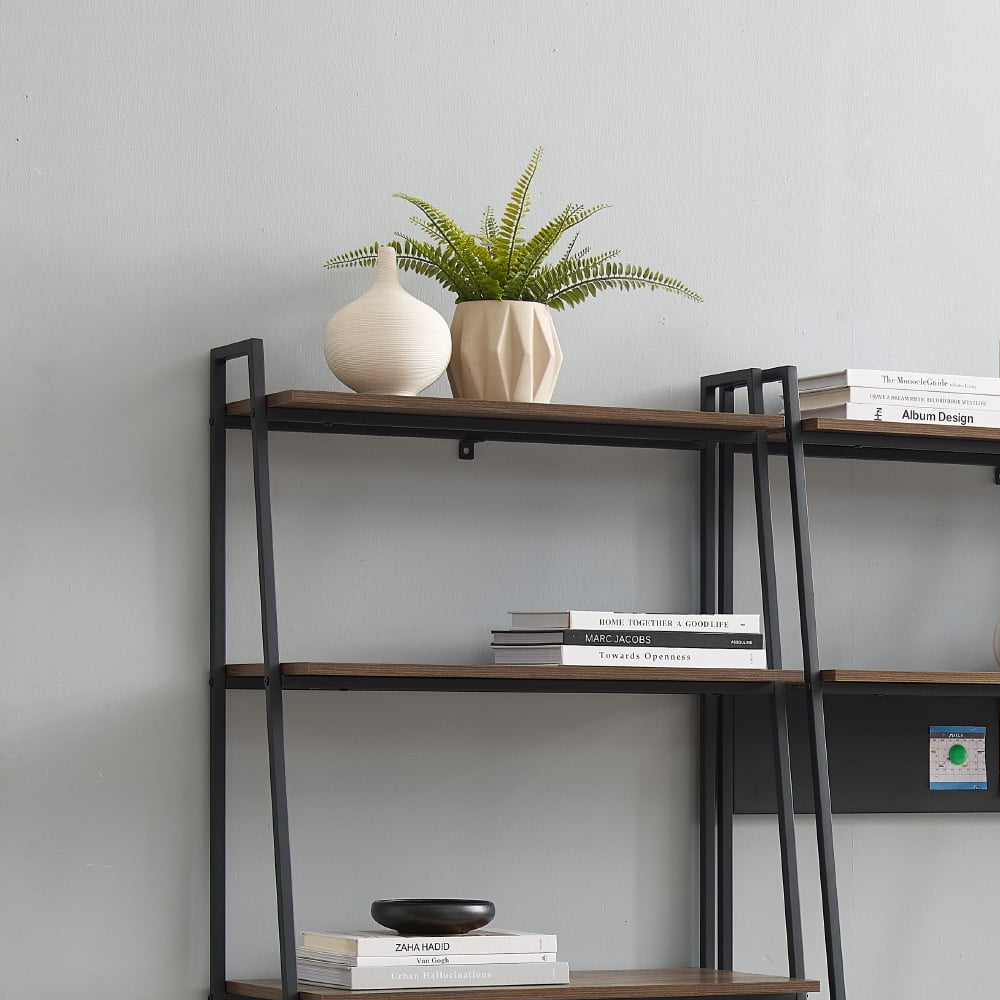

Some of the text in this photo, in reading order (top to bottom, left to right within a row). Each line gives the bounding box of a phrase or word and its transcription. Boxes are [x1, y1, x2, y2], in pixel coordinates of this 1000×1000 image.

[882, 375, 896, 384] The
[902, 410, 974, 425] Album Design
[599, 619, 625, 627] HOME
[628, 619, 673, 627] TOGETHER
[585, 634, 651, 644] MARC JACOBS
[598, 651, 691, 662] Towards Openness
[395, 942, 450, 952] ZAHA HADID
[416, 957, 450, 965] Van Gogh
[391, 970, 492, 981] Urban Hallucinations
